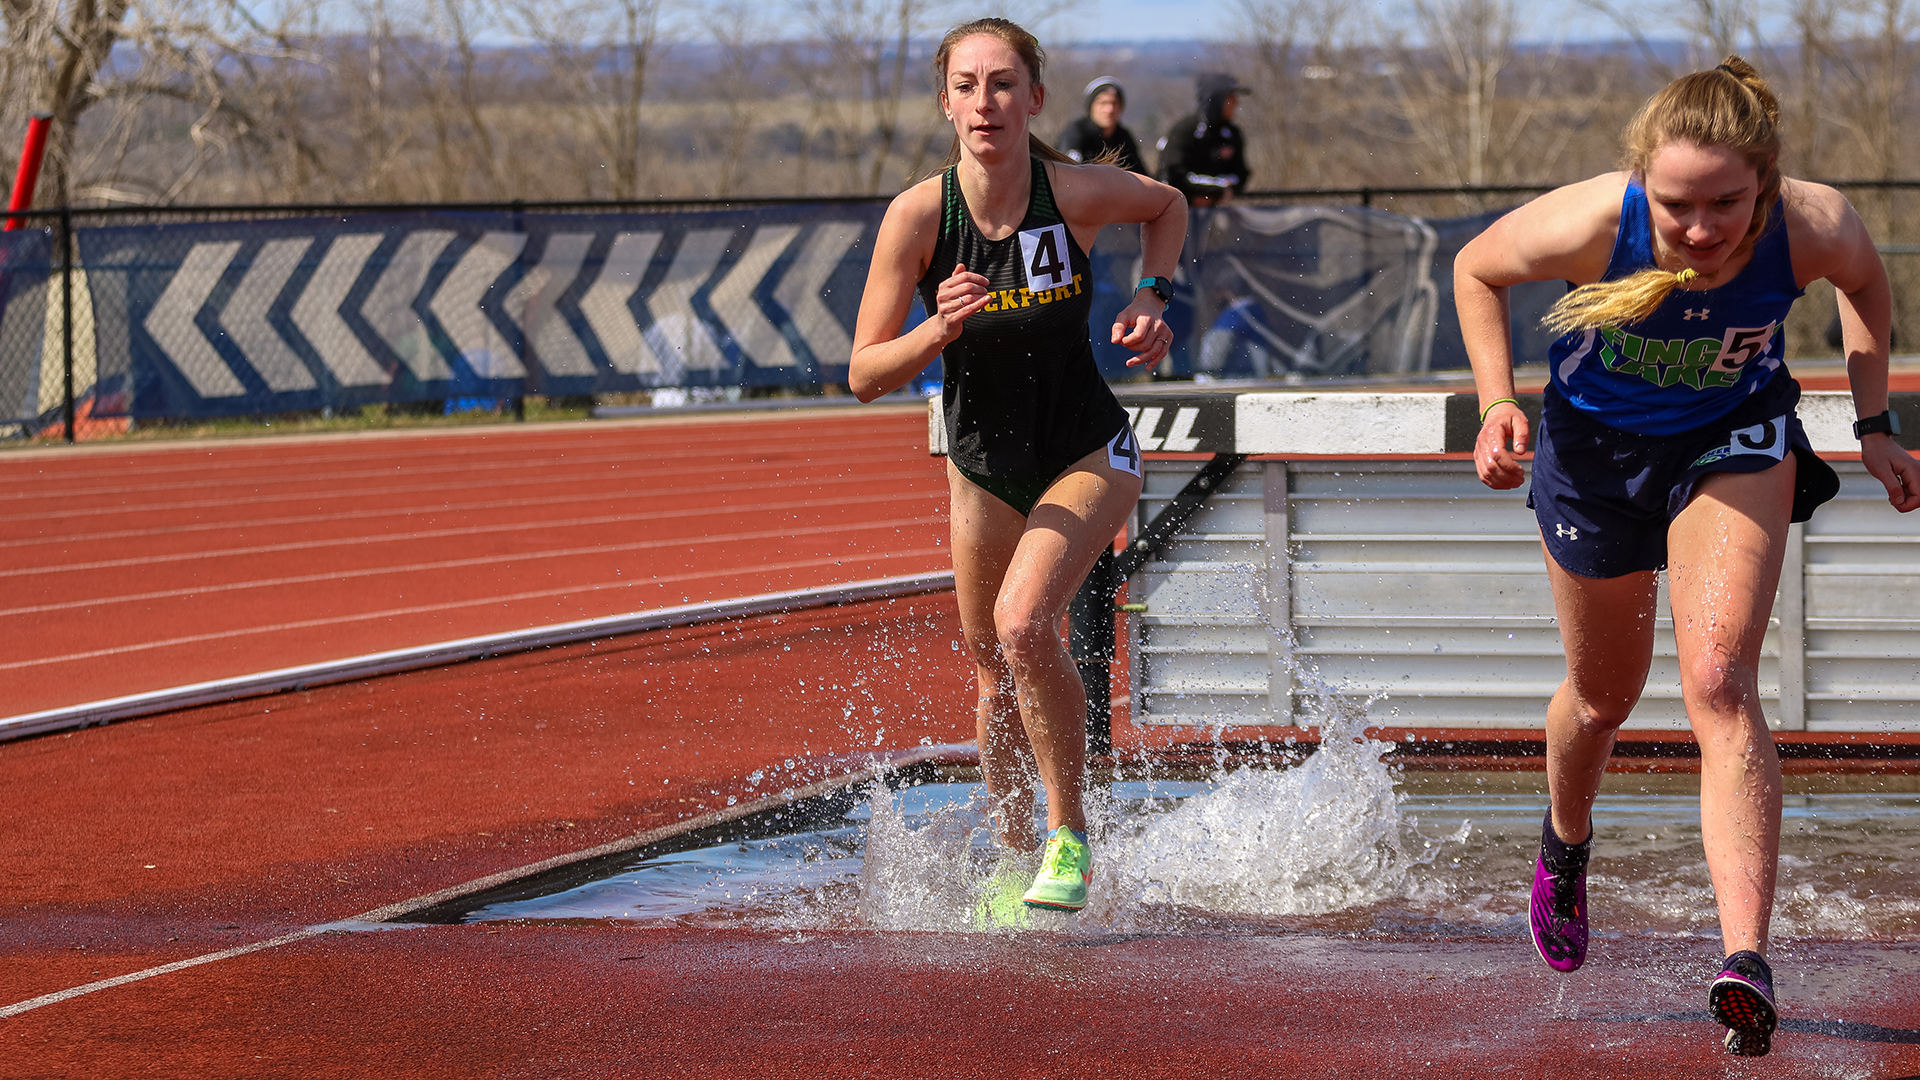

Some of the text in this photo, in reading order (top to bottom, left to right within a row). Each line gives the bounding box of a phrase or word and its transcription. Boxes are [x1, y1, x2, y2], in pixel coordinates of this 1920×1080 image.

[1031, 230, 1065, 284] 4
[975, 273, 1083, 313] CKPORT
[1599, 322, 1732, 366] FING
[1722, 328, 1768, 369] 5
[1599, 344, 1742, 391] LAKE
[1112, 416, 1138, 471] 4
[1123, 407, 1201, 452] LL
